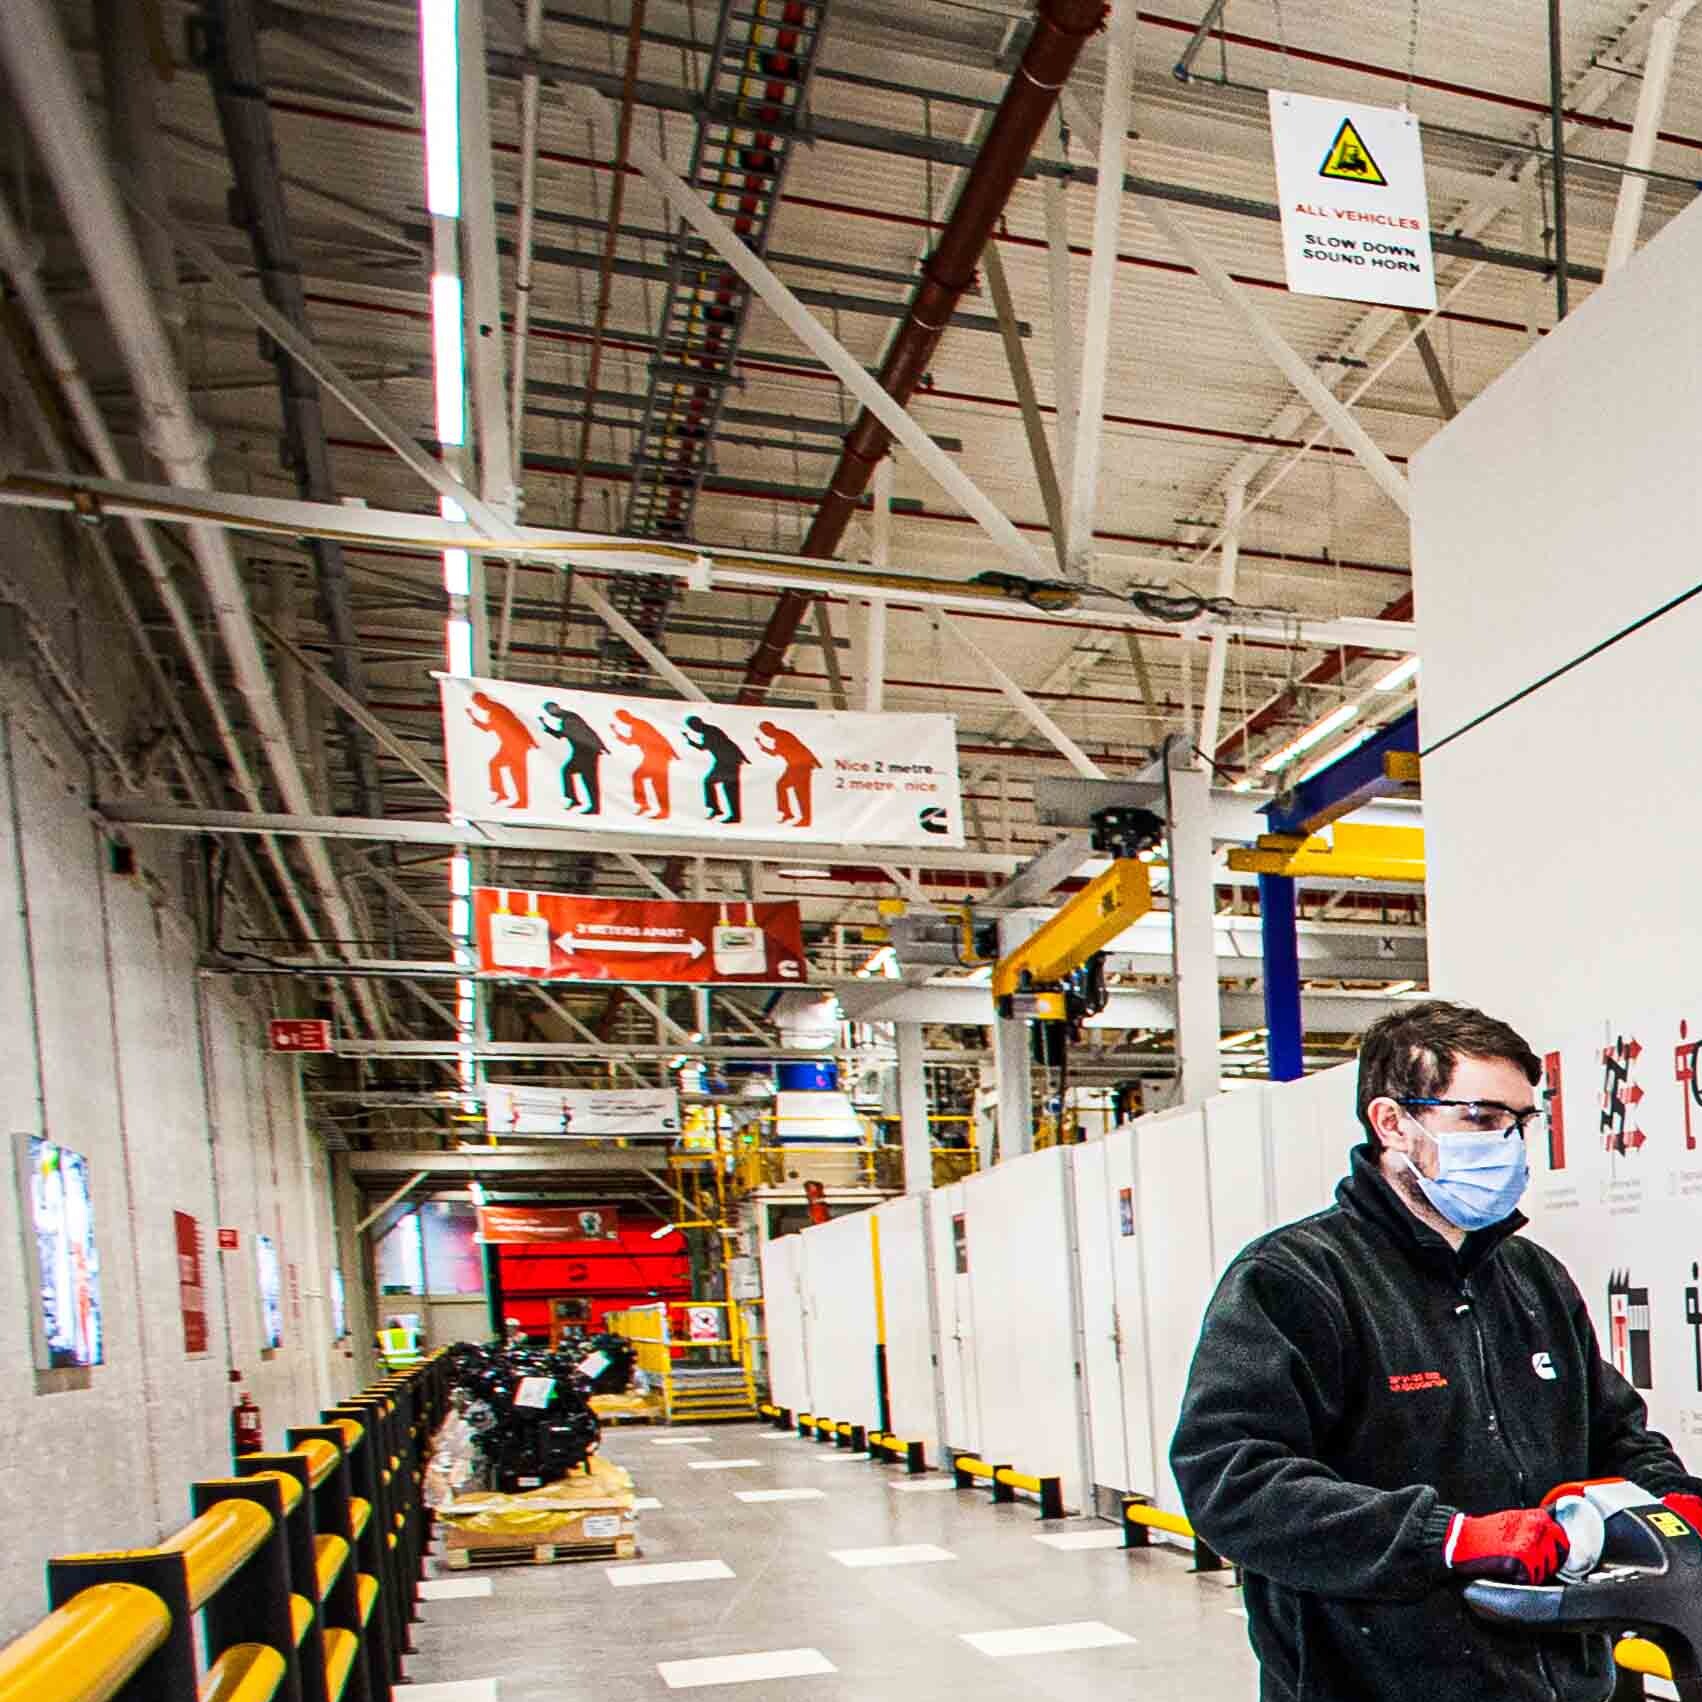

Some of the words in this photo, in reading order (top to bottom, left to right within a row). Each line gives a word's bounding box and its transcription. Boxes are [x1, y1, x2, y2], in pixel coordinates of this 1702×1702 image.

[1295, 203, 1328, 218] ALL
[1333, 207, 1421, 231] VEHICLES
[1304, 233, 1357, 250] SLOW
[1362, 241, 1416, 258] DOWN
[1303, 248, 1366, 266] SOUND
[1371, 257, 1421, 273] HORN
[834, 759, 870, 773] Nice
[875, 761, 884, 773] 2
[835, 777, 845, 789] 2
